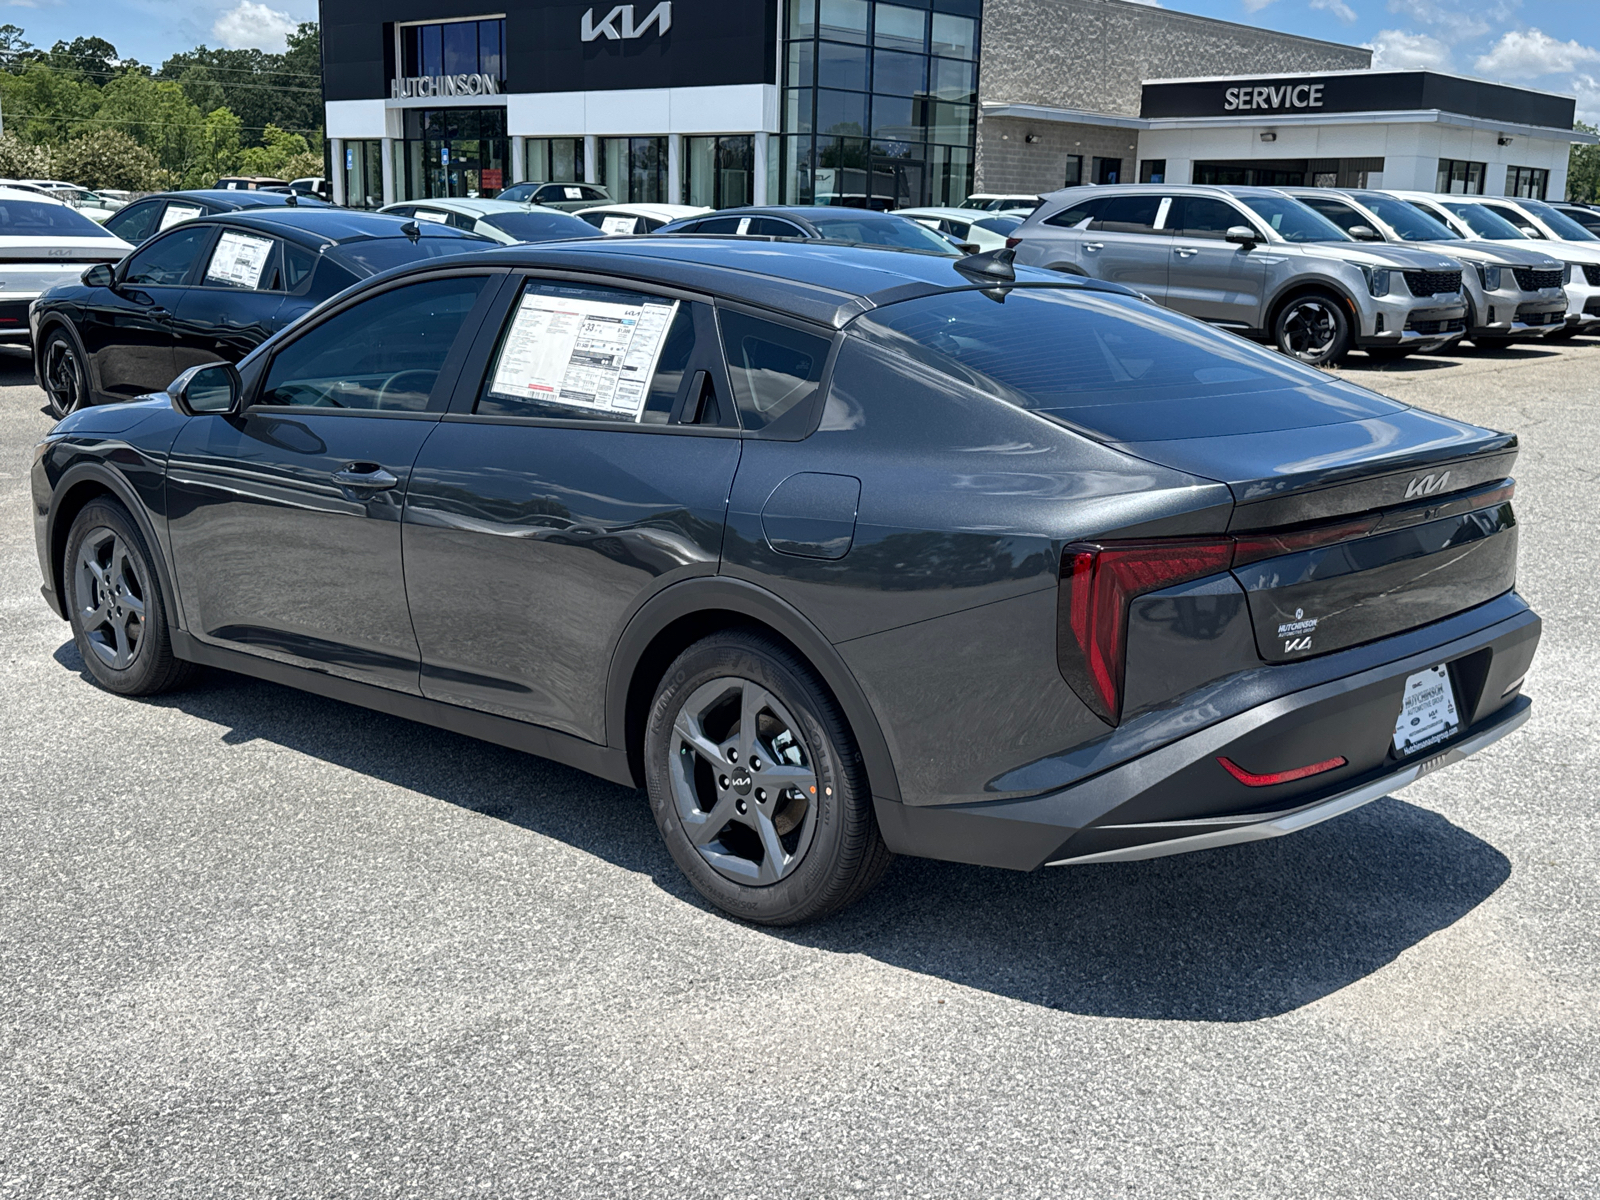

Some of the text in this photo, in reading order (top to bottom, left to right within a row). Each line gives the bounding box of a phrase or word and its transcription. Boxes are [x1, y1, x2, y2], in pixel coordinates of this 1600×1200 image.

[581, 1, 672, 42] KIA
[391, 73, 496, 100] HUTCHINSON
[1224, 84, 1325, 111] SERVICE
[1404, 471, 1451, 499] KIA
[1278, 619, 1318, 633] HUTCHINSON
[1284, 636, 1312, 653] K4
[651, 669, 686, 735] KUMHO
[732, 777, 751, 786] KIA
